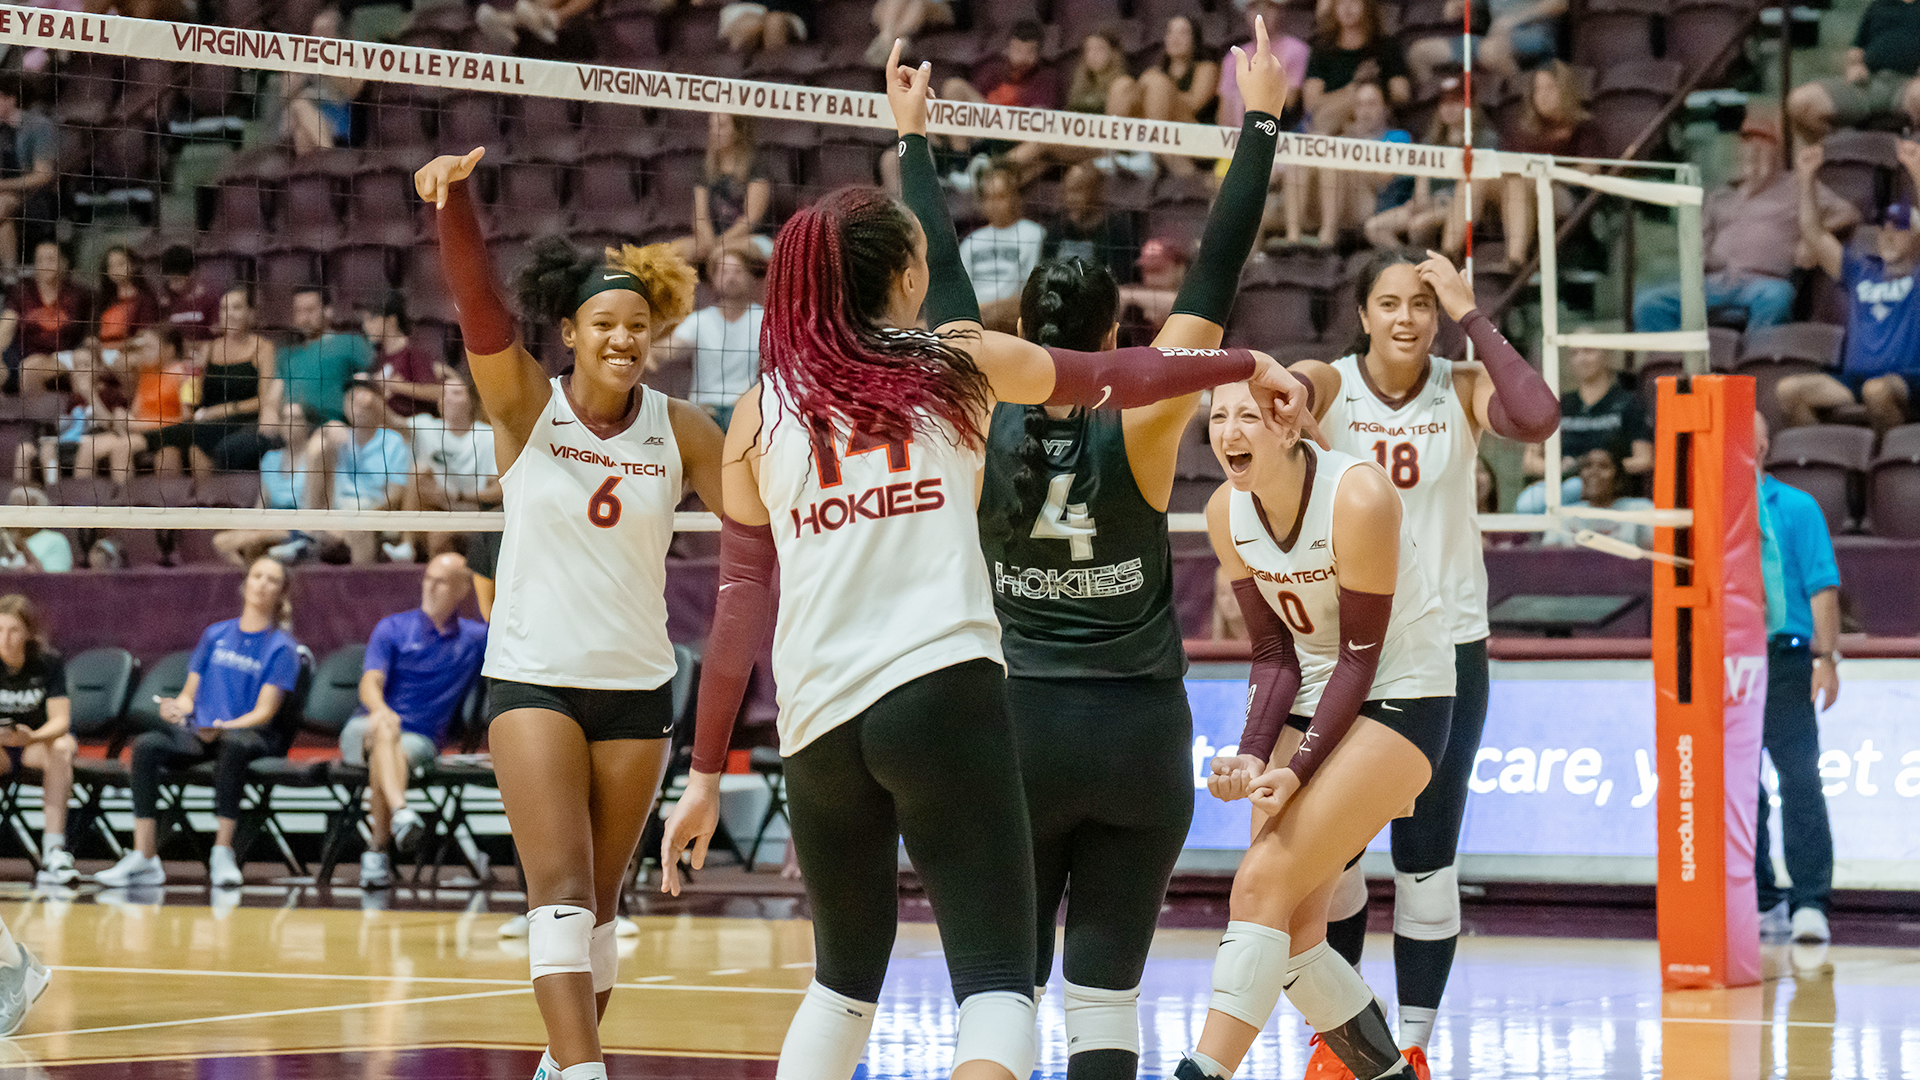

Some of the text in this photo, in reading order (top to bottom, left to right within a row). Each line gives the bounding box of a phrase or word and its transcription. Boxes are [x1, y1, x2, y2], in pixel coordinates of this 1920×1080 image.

[171, 24, 285, 60] VIRGINIA
[291, 38, 355, 68] TECH
[362, 47, 525, 84] VOLLEYBALL
[576, 66, 672, 98] VIRGINIA
[675, 77, 732, 103] TECH
[738, 85, 878, 118] VOLLEYBALL
[1007, 109, 1054, 133] TECH
[1061, 116, 1181, 146] VOLLEYBALL
[1293, 136, 1337, 158] TECH
[1342, 143, 1445, 168] VOLLEYBALL
[1042, 439, 1074, 456] VT
[1409, 422, 1447, 436] TECH
[620, 463, 666, 477] TECH
[1371, 440, 1420, 489] 18
[587, 475, 623, 529] 6
[790, 477, 945, 539] HOKIES
[1029, 473, 1097, 561] 4
[995, 557, 1144, 600] HOKIES
[1292, 565, 1336, 584] TECH
[1277, 590, 1315, 635] 0
[1724, 656, 1764, 704] VT
[1468, 747, 1613, 807] care,
[1676, 734, 1695, 799] sports
